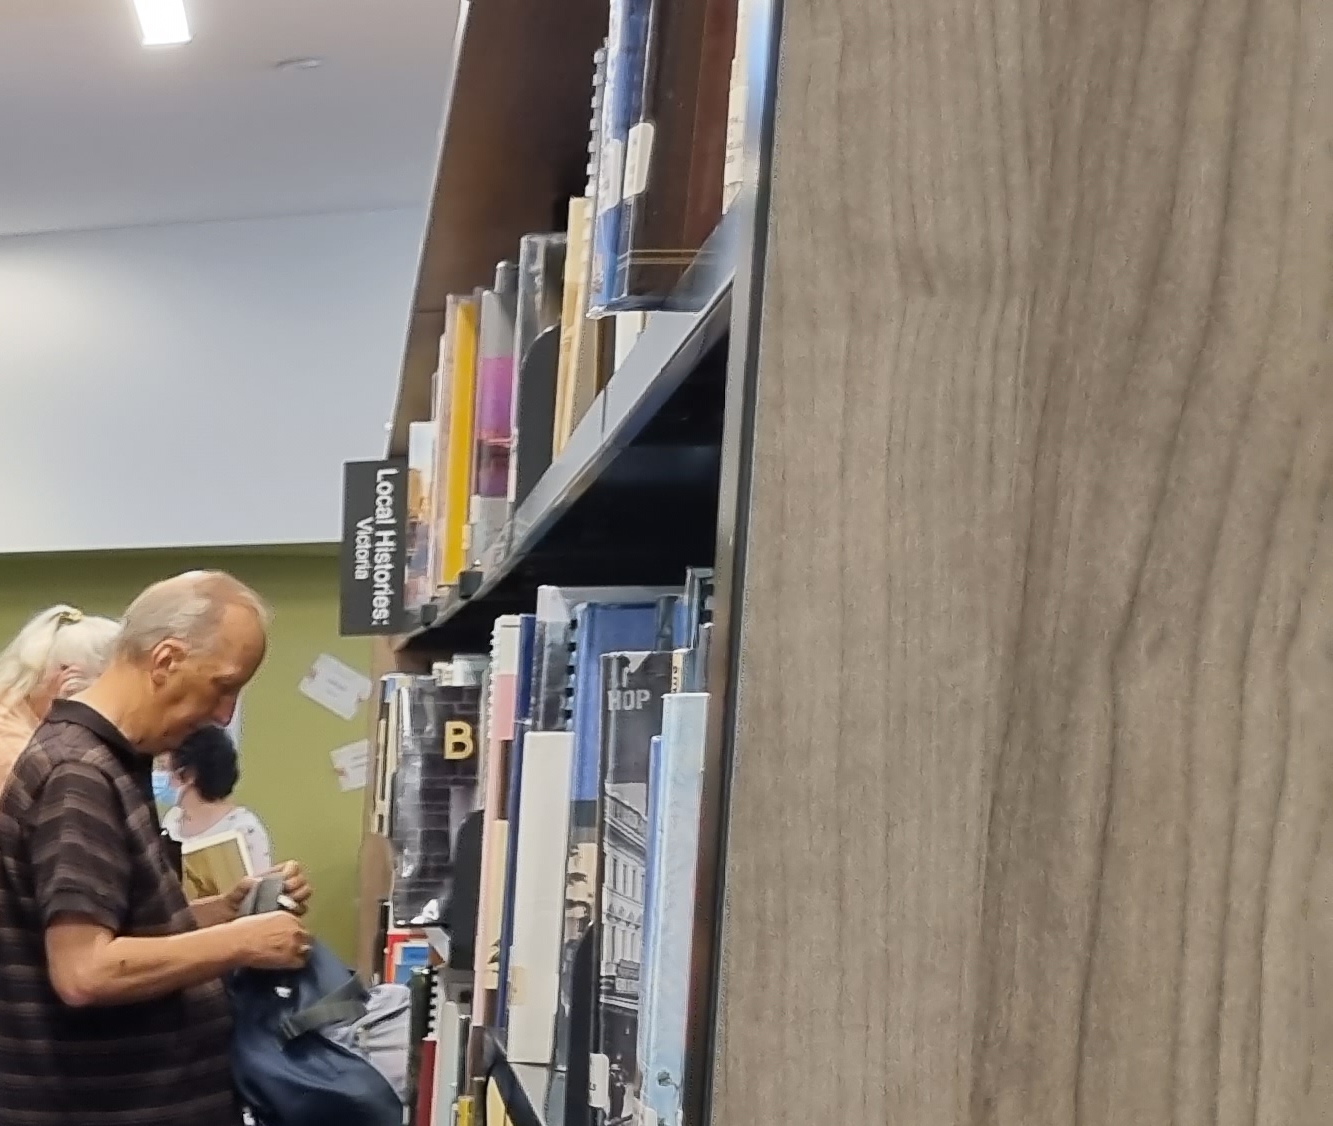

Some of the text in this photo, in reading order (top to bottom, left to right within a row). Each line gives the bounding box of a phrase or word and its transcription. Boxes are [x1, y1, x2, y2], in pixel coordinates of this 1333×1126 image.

[354, 516, 375, 580] Victoria
[371, 468, 400, 626] Local Histories:
[444, 721, 474, 760] B
